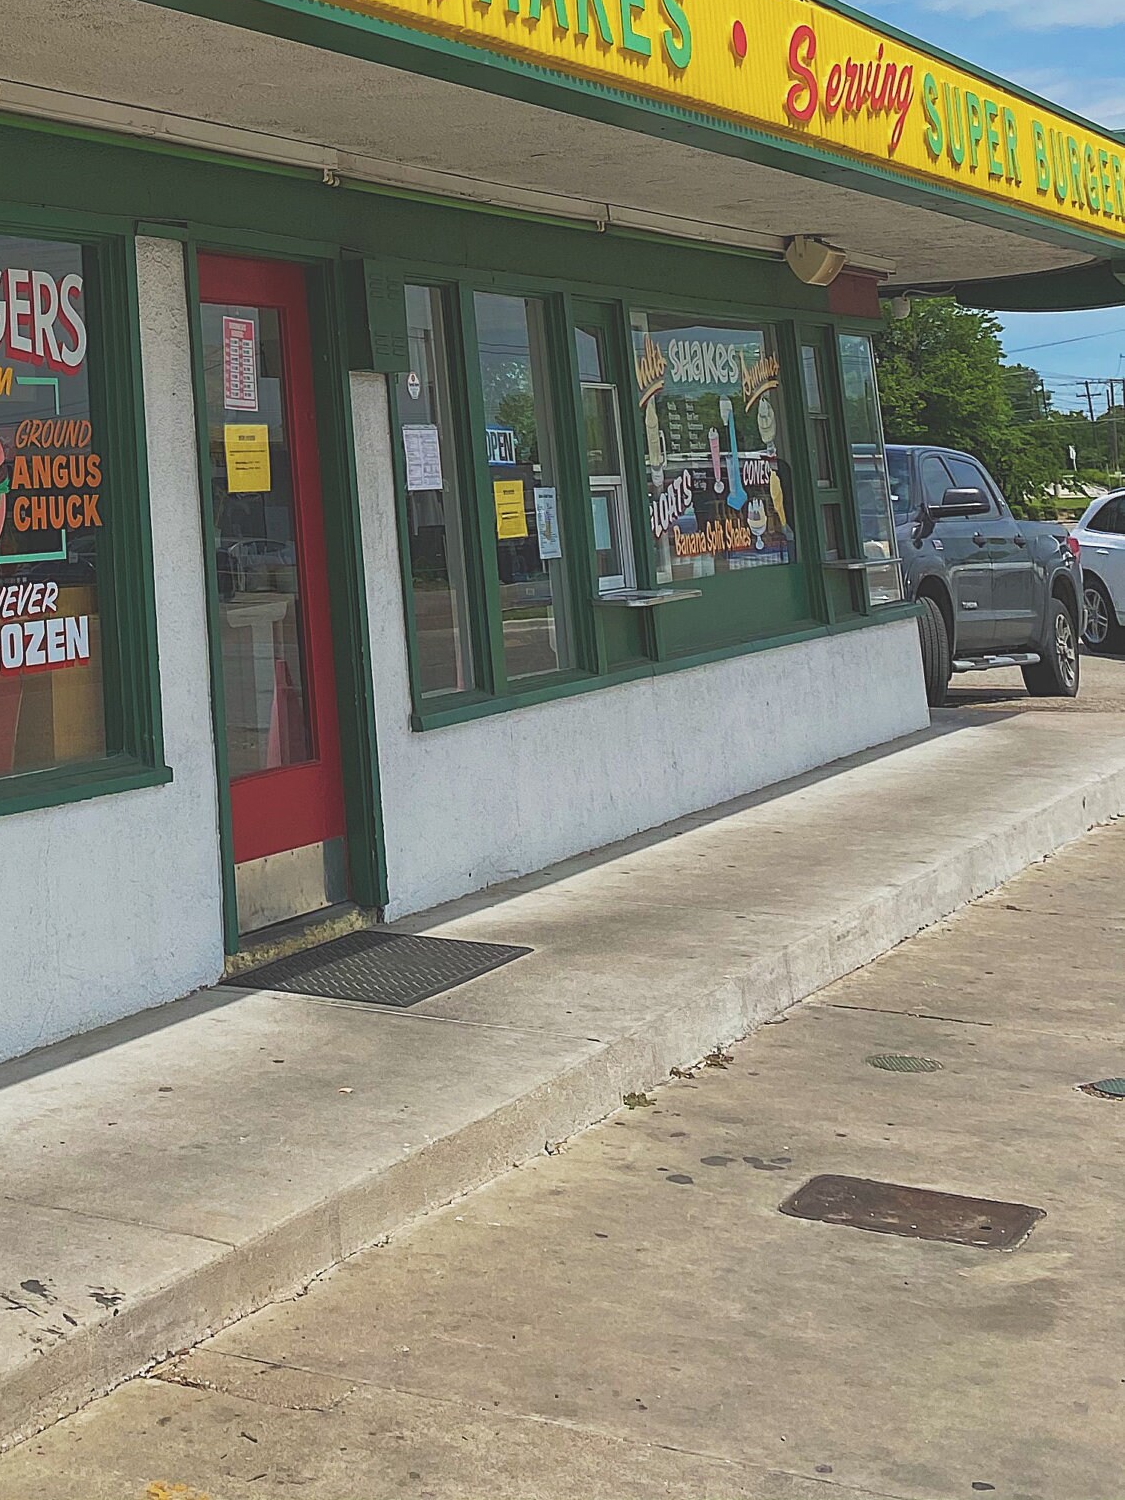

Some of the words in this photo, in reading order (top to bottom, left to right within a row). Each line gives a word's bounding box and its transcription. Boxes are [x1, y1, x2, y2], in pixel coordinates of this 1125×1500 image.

[786, 24, 913, 151] Serving
[923, 72, 1021, 181] SUPER
[15, 419, 92, 448] GROUND
[11, 454, 102, 489] ANGUS
[743, 460, 771, 486] CONES
[13, 494, 103, 532] CHUCK
[674, 525, 707, 556] Banana
[706, 520, 725, 556] Split
[725, 518, 751, 549] Shakes
